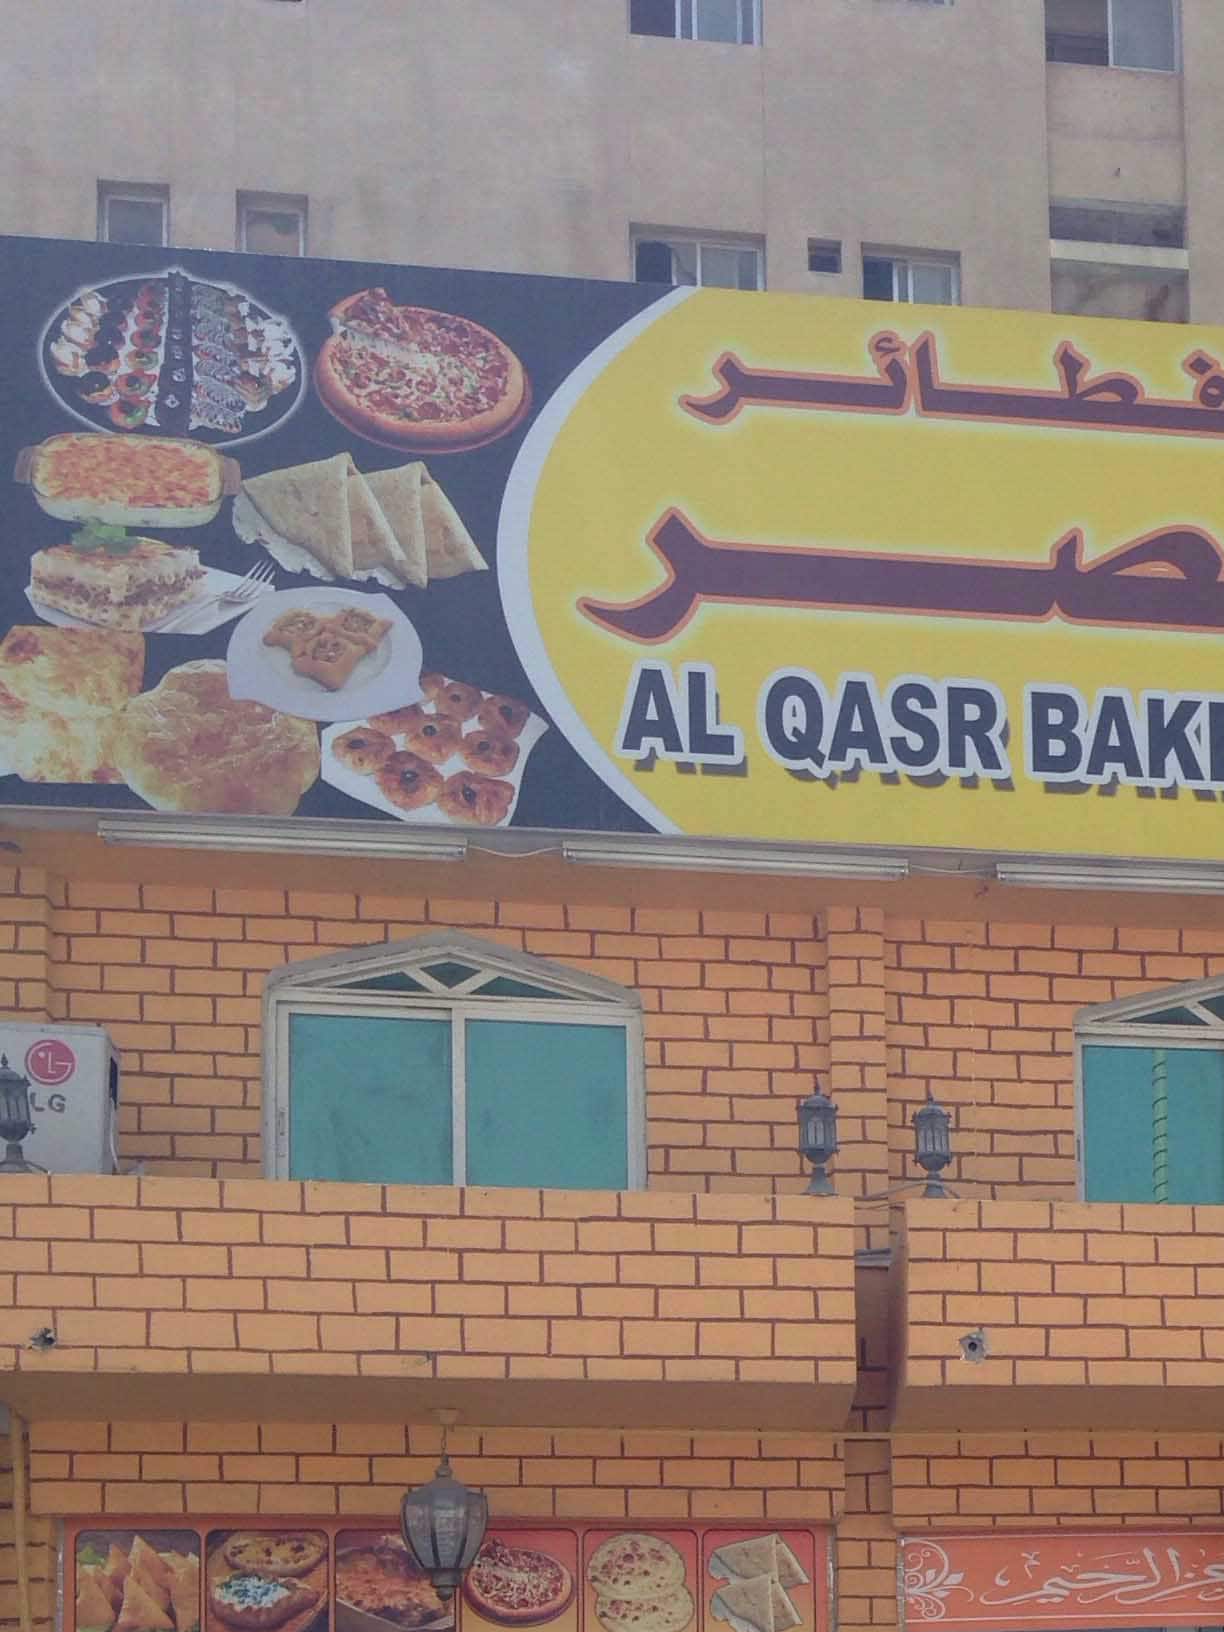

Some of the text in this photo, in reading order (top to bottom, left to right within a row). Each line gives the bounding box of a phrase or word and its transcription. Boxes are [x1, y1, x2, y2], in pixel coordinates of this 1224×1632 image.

[622, 666, 737, 756] AL
[764, 674, 1003, 774] QASR
[30, 1092, 67, 1113] LG
